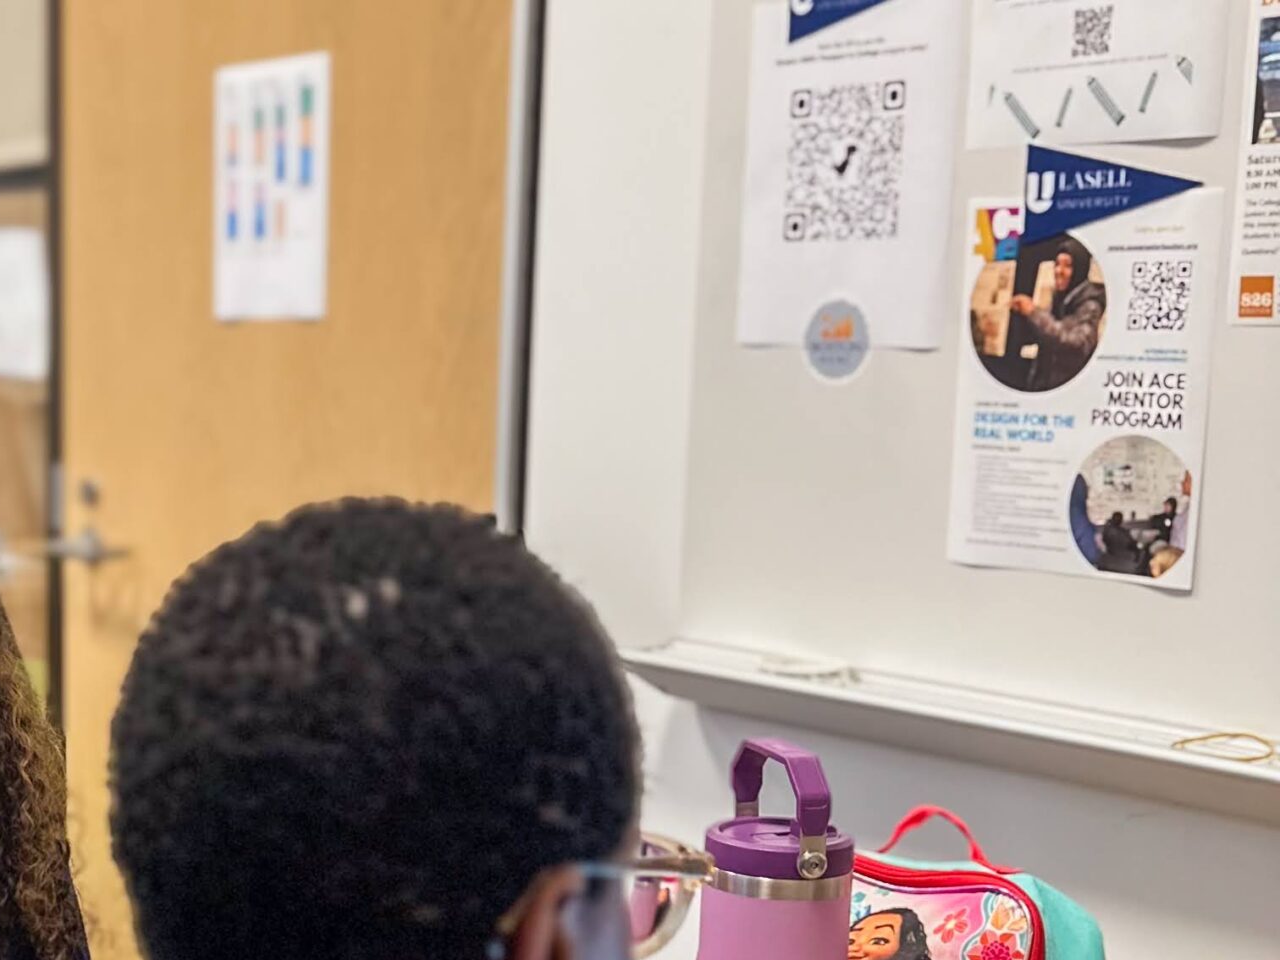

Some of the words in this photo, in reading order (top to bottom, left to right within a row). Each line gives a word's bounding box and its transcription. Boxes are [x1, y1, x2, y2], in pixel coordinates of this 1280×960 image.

[1059, 168, 1132, 191] LASELL
[1057, 196, 1130, 210] UNIVERSITY
[1241, 292, 1272, 307] 826
[1103, 371, 1143, 388] JOIN
[1149, 373, 1186, 389] ACE
[1108, 391, 1183, 409] MENTOR
[975, 411, 1019, 424] DESIGN
[1023, 414, 1048, 426] FOR
[1053, 415, 1075, 428] THE
[1091, 409, 1182, 429] PROGRAM
[974, 427, 1001, 439] REAL
[1007, 430, 1054, 443] WORLD
